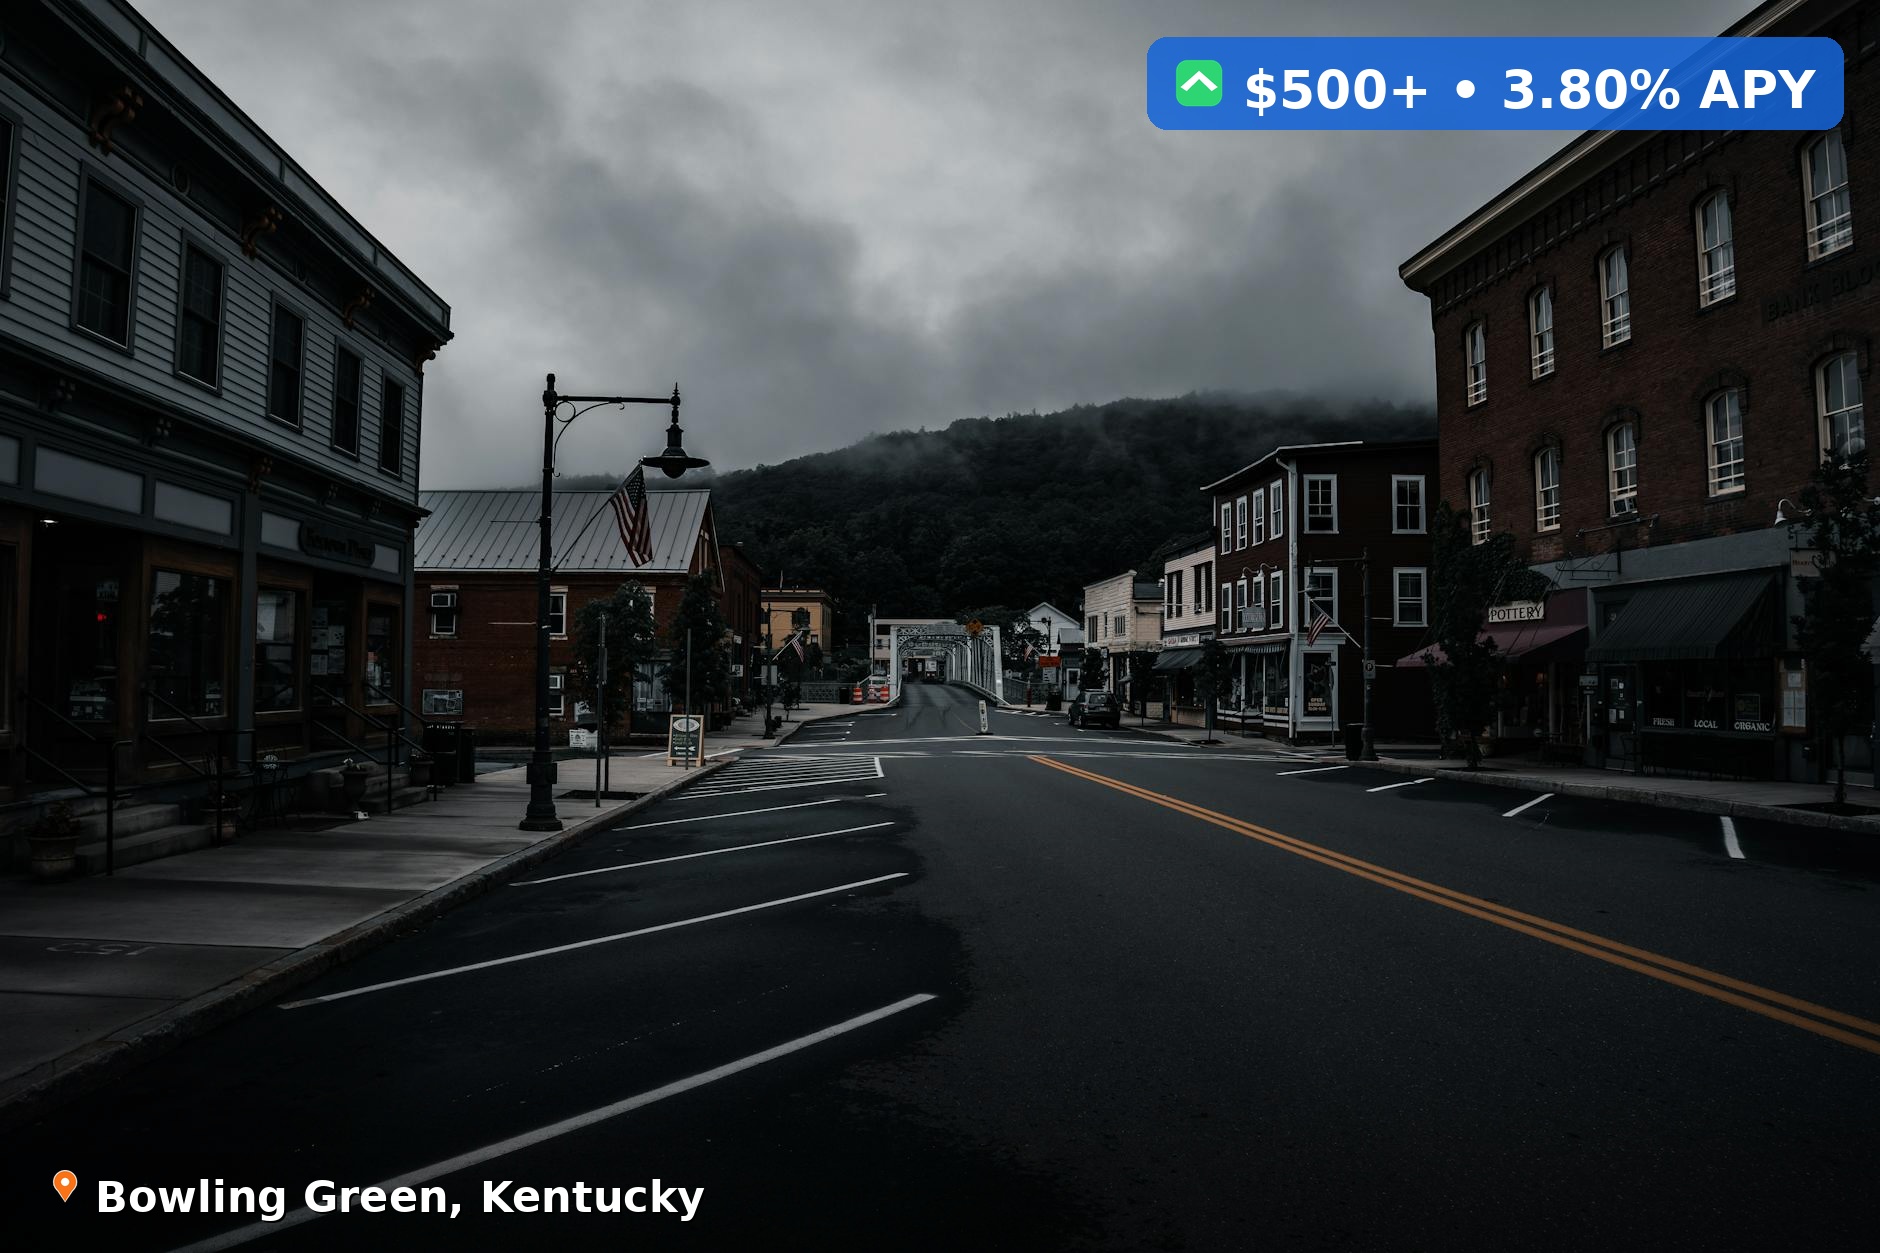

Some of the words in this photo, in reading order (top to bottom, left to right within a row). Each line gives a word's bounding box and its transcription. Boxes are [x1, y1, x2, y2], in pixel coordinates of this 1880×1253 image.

[1768, 282, 1822, 321] BANK
[1490, 605, 1542, 621] POTTERY
[1651, 717, 1675, 727] FRESH
[1693, 719, 1719, 729] LOCAL
[1733, 721, 1771, 732] ORGANIC
